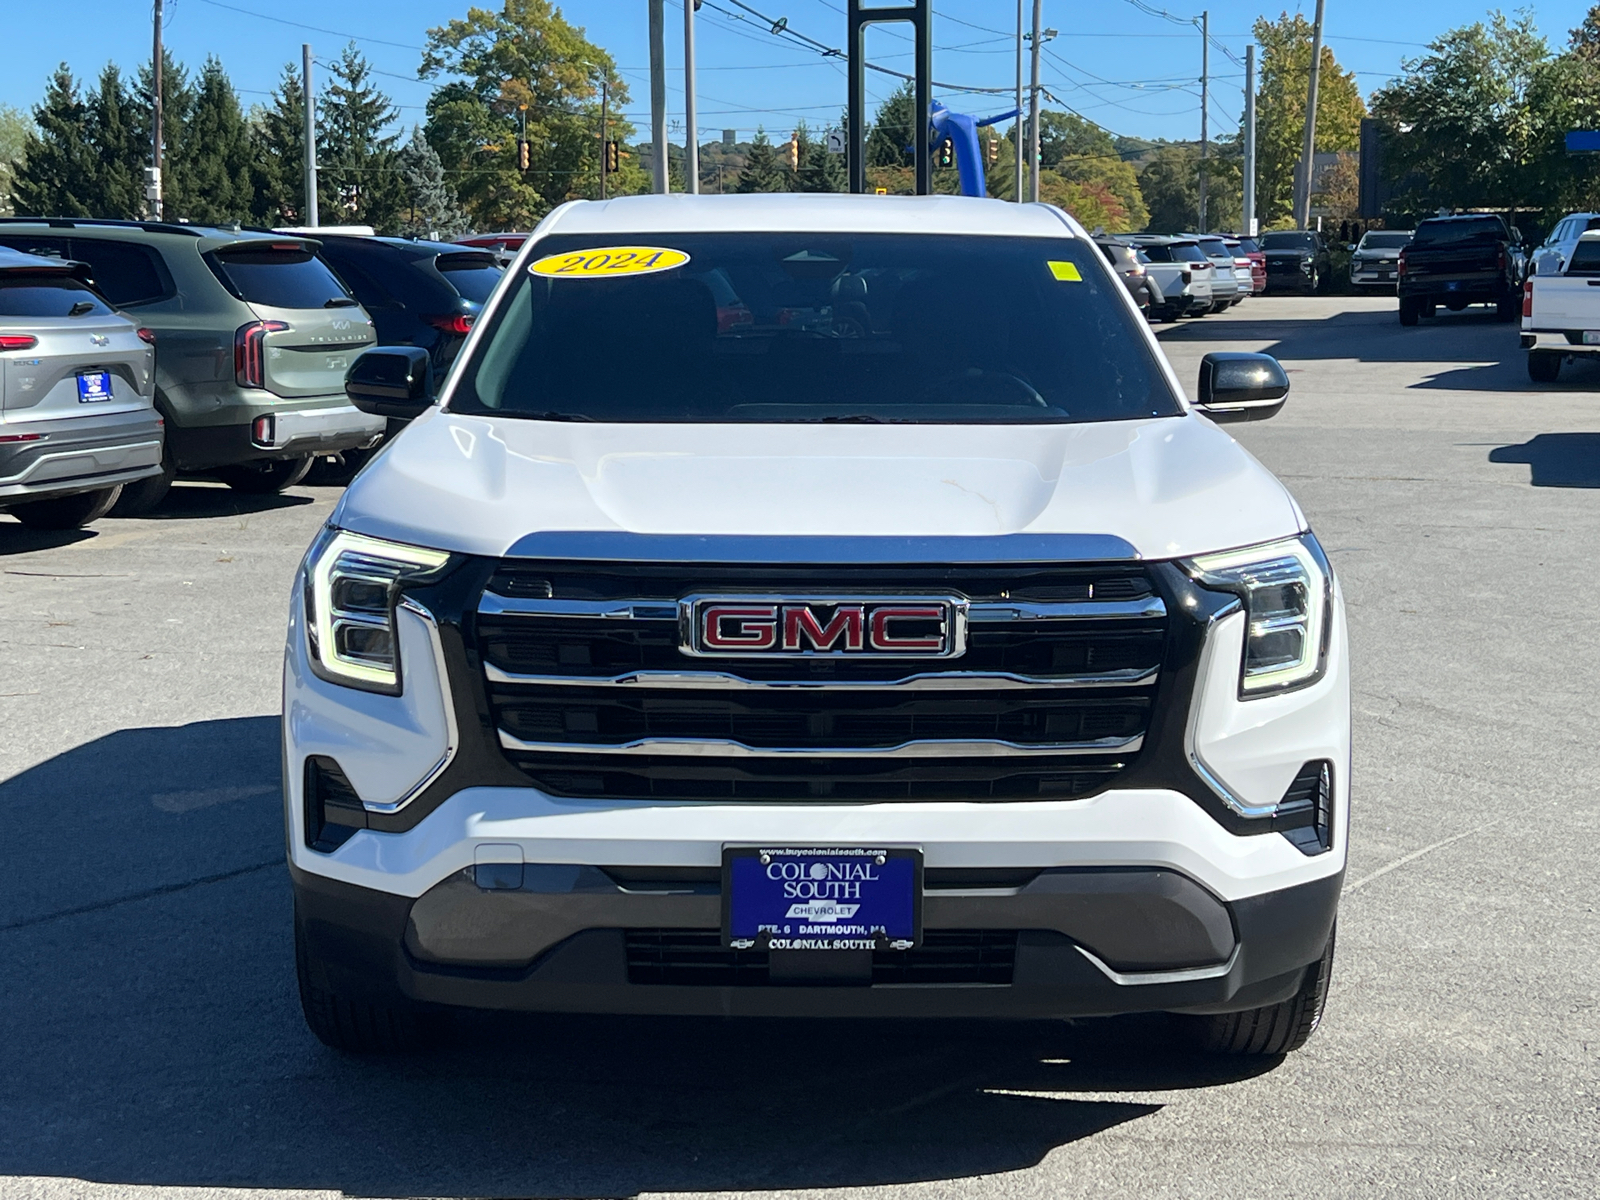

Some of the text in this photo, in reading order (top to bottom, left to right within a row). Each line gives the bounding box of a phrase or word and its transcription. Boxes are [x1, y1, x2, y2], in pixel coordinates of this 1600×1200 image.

[554, 251, 665, 274] 2024
[702, 605, 945, 651] GMC
[759, 848, 887, 857] www.buycolonialsouth.com
[766, 862, 879, 881] COLONIAL
[784, 882, 861, 898] SOUTH
[793, 906, 852, 915] CHEVROLET
[783, 924, 791, 934] 6
[799, 924, 868, 935] DARTMOUTH,
[768, 939, 876, 950] COLONIAL SOUTH
